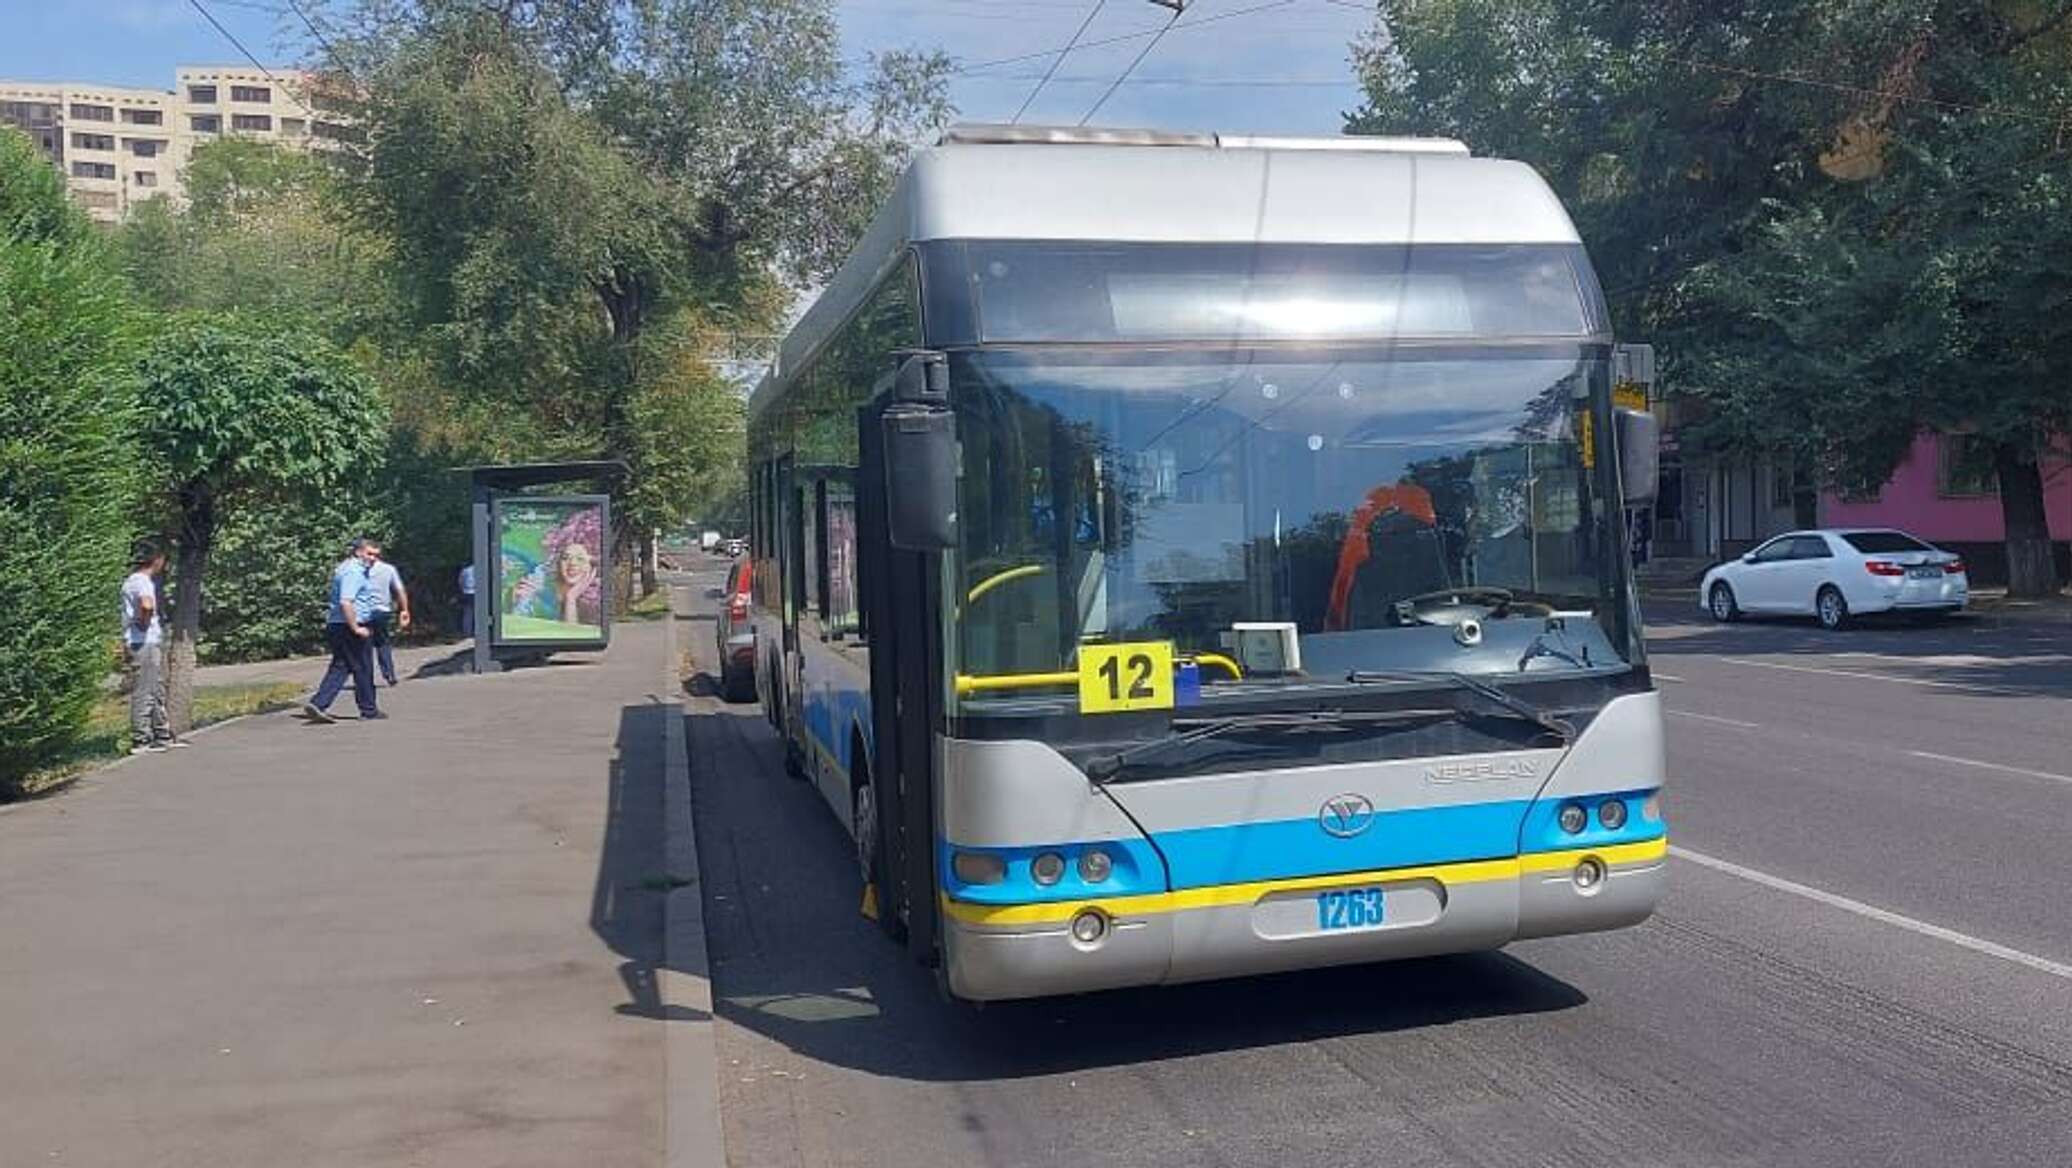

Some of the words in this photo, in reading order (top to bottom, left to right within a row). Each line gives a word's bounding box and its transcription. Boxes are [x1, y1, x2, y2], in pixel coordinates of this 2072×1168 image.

[1099, 654, 1154, 700] 12
[1423, 760, 1540, 785] NEOPLAN
[1317, 887, 1384, 929] 1263
